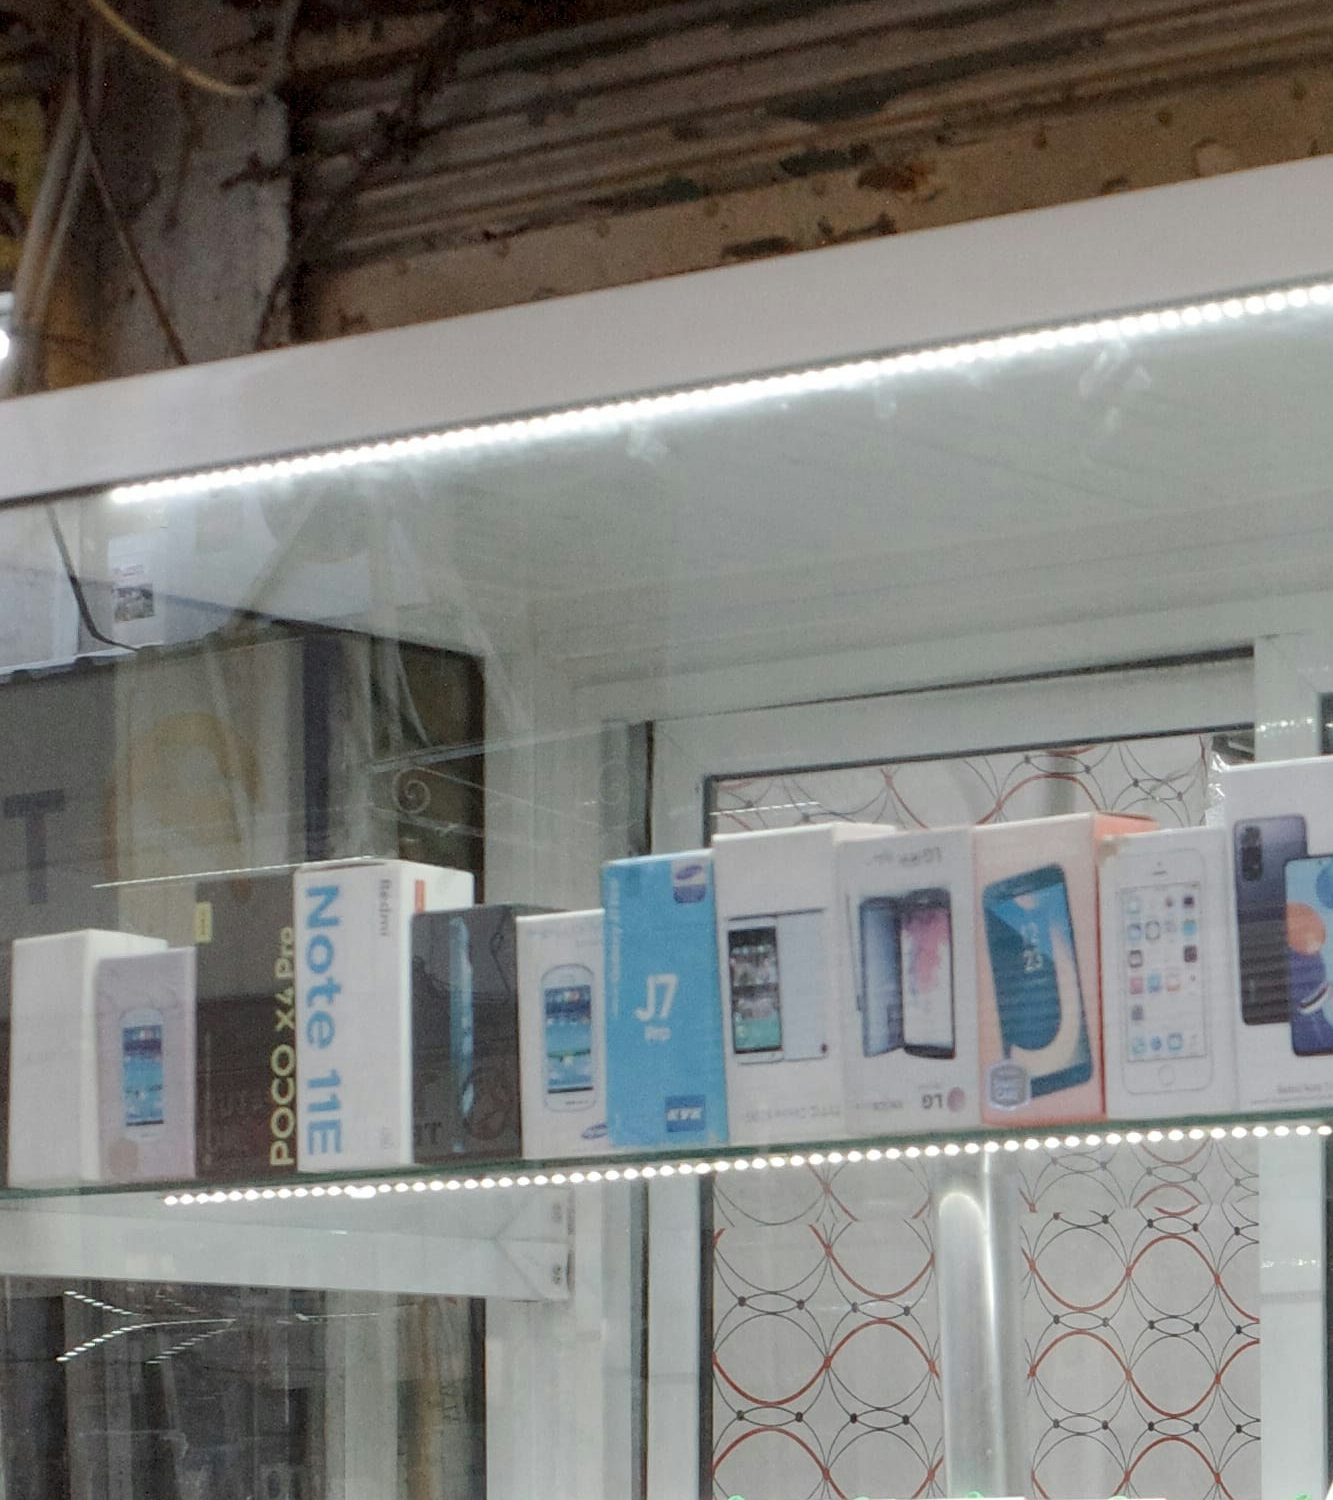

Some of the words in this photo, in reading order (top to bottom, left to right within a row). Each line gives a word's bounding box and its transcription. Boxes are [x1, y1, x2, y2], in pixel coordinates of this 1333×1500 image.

[273, 927, 295, 980] Pro
[306, 885, 342, 1050] Note
[274, 987, 295, 1033] X4
[636, 973, 678, 1023] J7
[270, 1043, 296, 1167] POCO
[306, 1068, 343, 1156] 11E
[921, 1093, 944, 1110] LG
